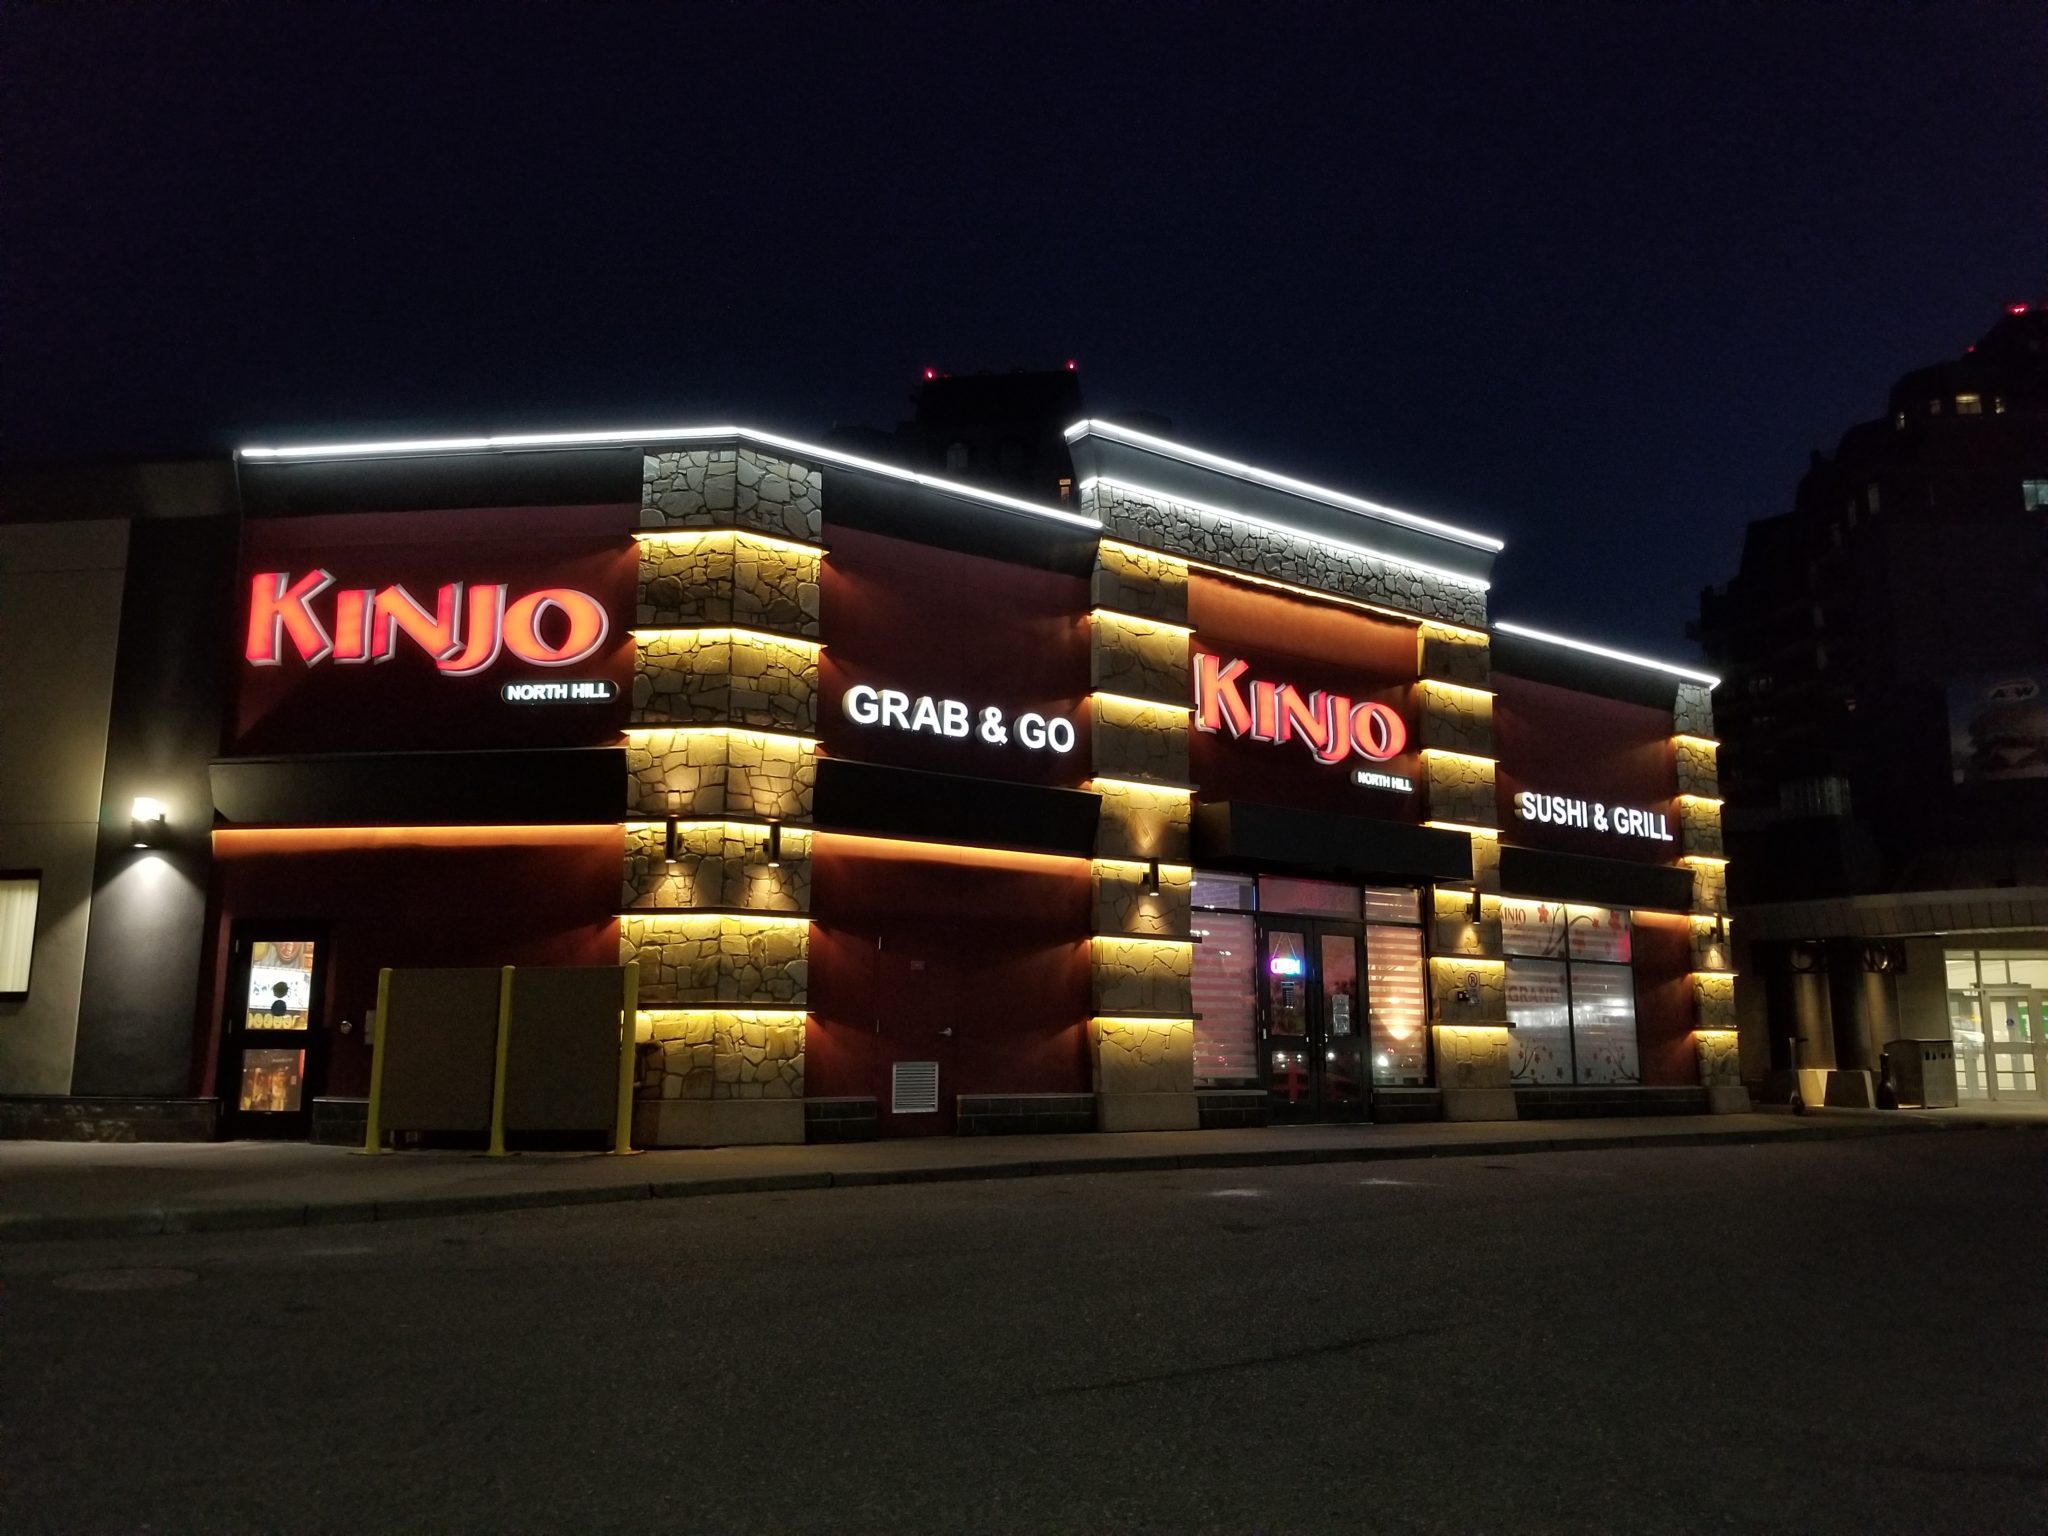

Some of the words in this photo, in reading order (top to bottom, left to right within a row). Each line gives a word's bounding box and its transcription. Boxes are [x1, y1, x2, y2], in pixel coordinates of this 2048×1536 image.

[246, 568, 609, 677] KINJO
[507, 684, 568, 700] NORTH
[571, 683, 610, 699] HILL
[1193, 653, 1407, 765] KINJO
[842, 685, 970, 738] GRAB
[976, 706, 1008, 745] &
[1014, 712, 1075, 753] GO
[1357, 770, 1391, 788] NORTH
[1391, 776, 1412, 791] HILL
[1515, 791, 1589, 828] SUSHI
[1591, 803, 1610, 832] &
[1609, 806, 1674, 841] GRILL
[1270, 958, 1303, 975] ON
